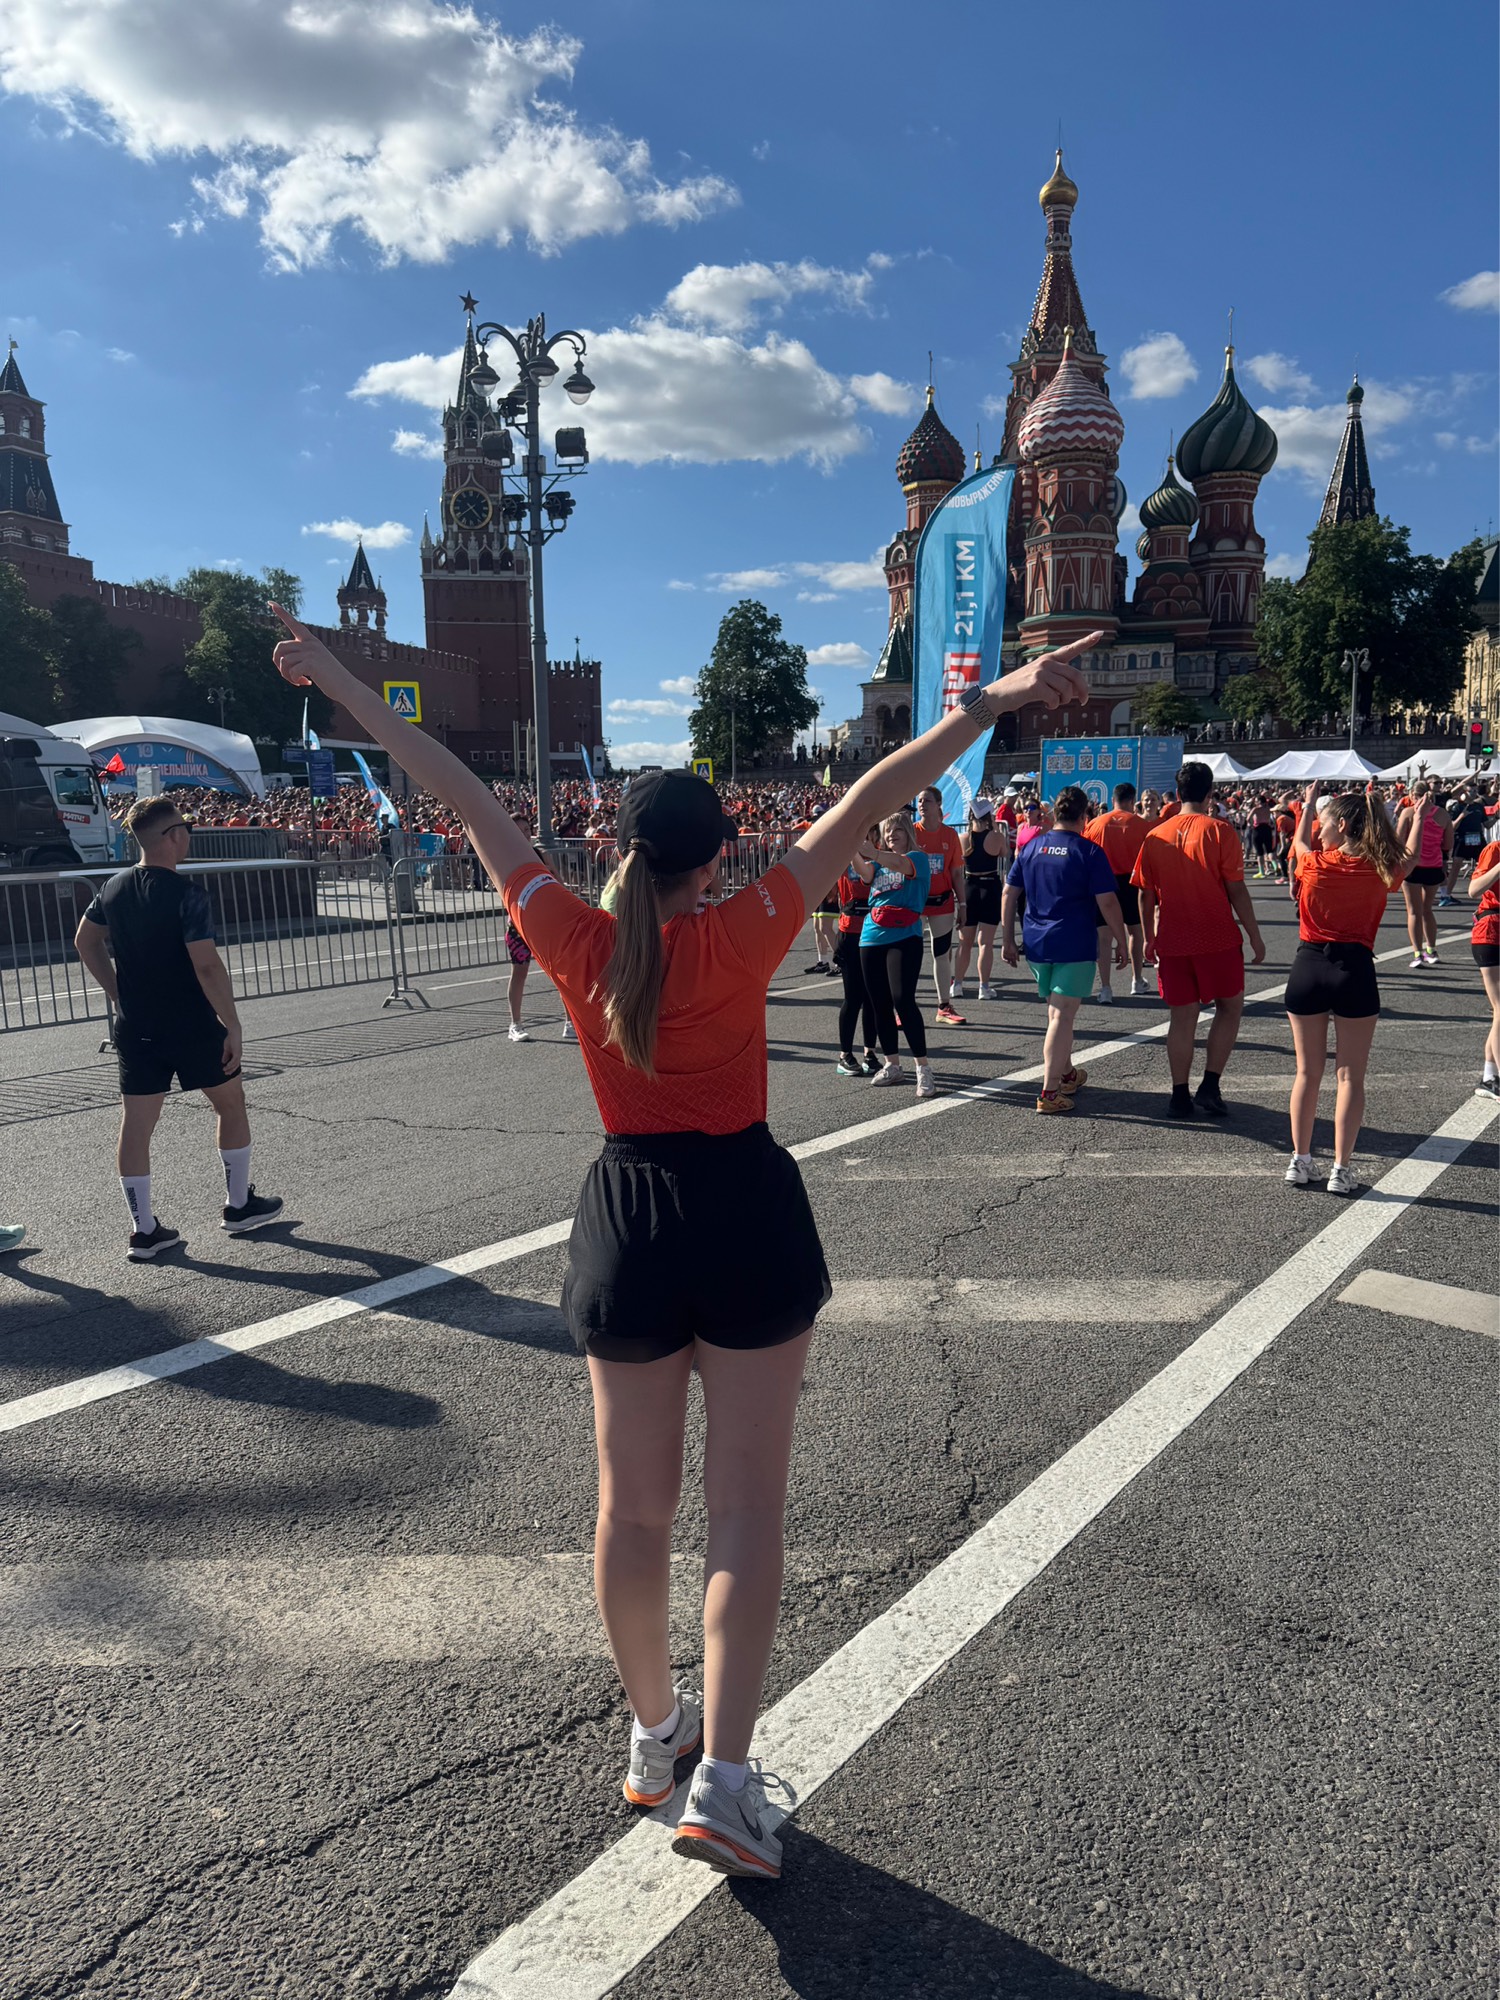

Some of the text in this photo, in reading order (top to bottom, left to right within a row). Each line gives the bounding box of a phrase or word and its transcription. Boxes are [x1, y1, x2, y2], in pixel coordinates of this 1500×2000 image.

[942, 540, 981, 718] АРТ 21,1 КМ
[144, 763, 209, 778] ЛЕЛЬЩИКА
[1047, 846, 1068, 856] ПСБ
